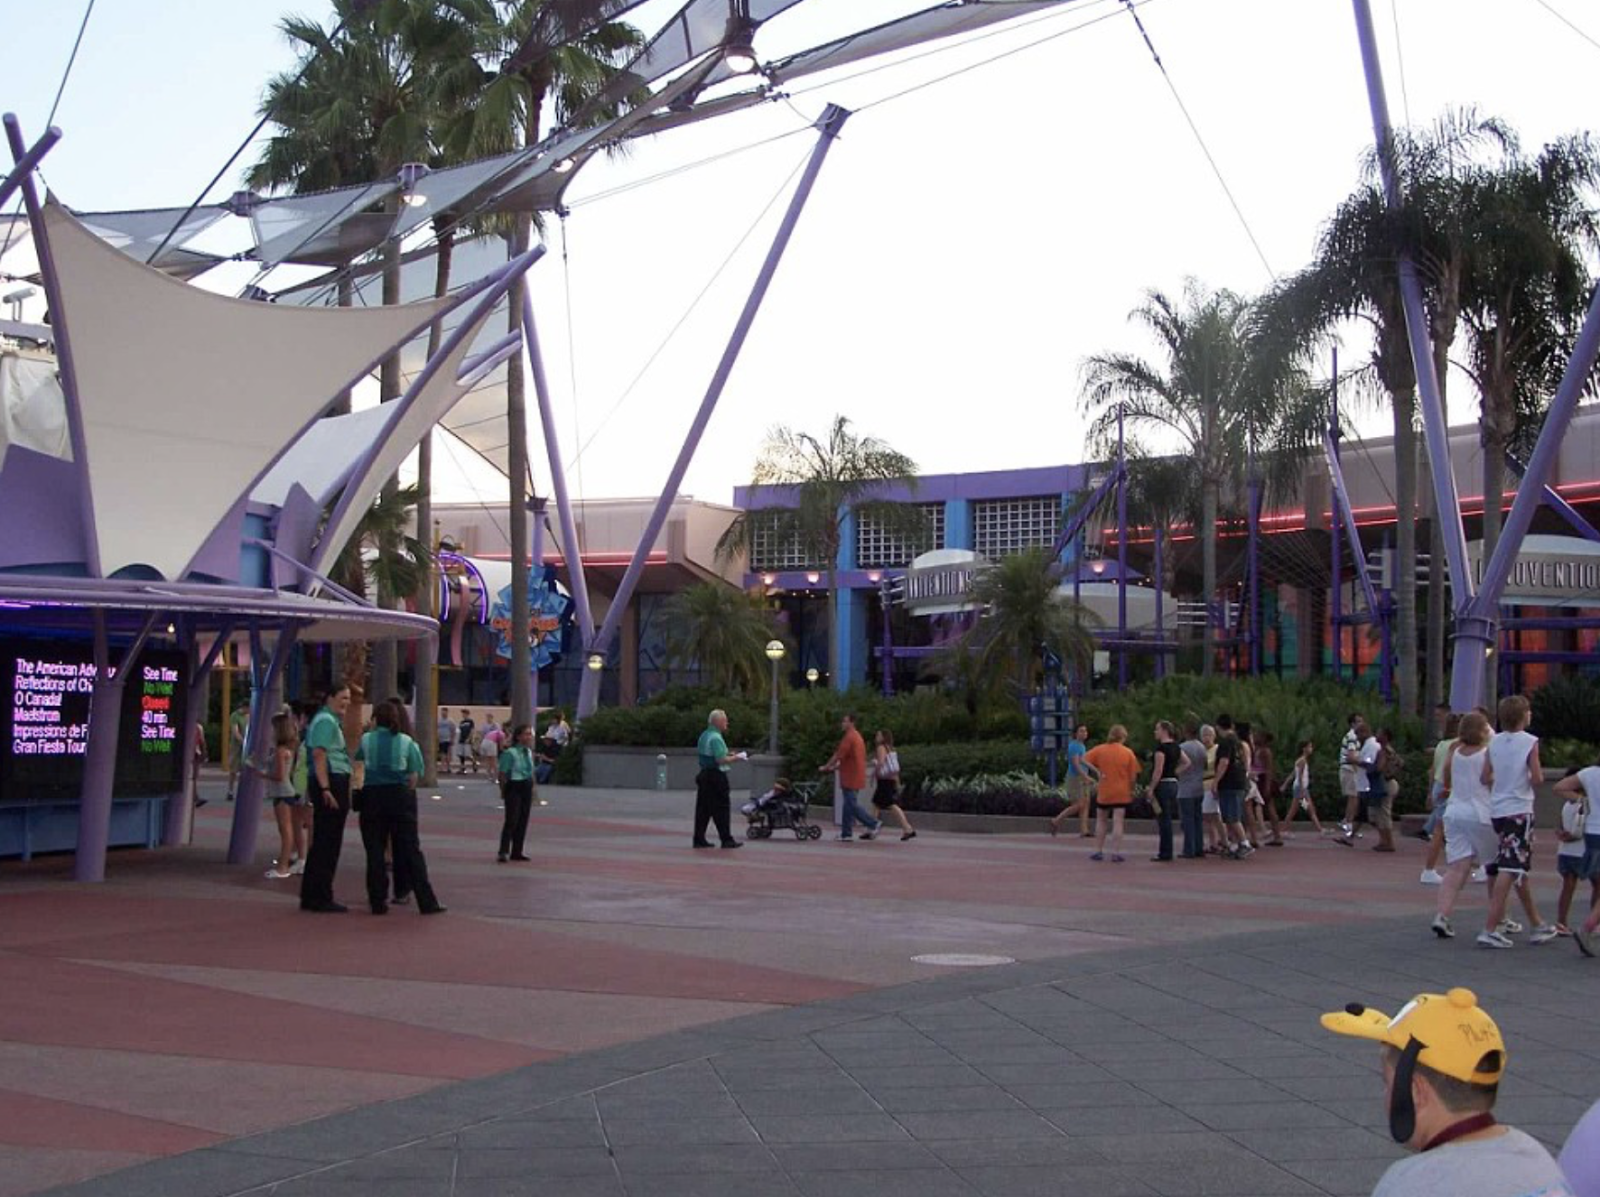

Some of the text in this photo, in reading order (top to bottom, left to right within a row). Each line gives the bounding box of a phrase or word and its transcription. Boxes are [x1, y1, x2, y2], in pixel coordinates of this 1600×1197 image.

[16, 658, 34, 674] The
[35, 660, 78, 677] American
[143, 666, 160, 681] See
[15, 675, 93, 693] Reflections of Chi
[14, 690, 24, 706] O
[141, 710, 168, 724] 40 min
[13, 723, 67, 741] Impressions
[68, 724, 81, 738] de
[141, 725, 157, 739] See
[13, 739, 86, 754] Gran Fiesta Tour
